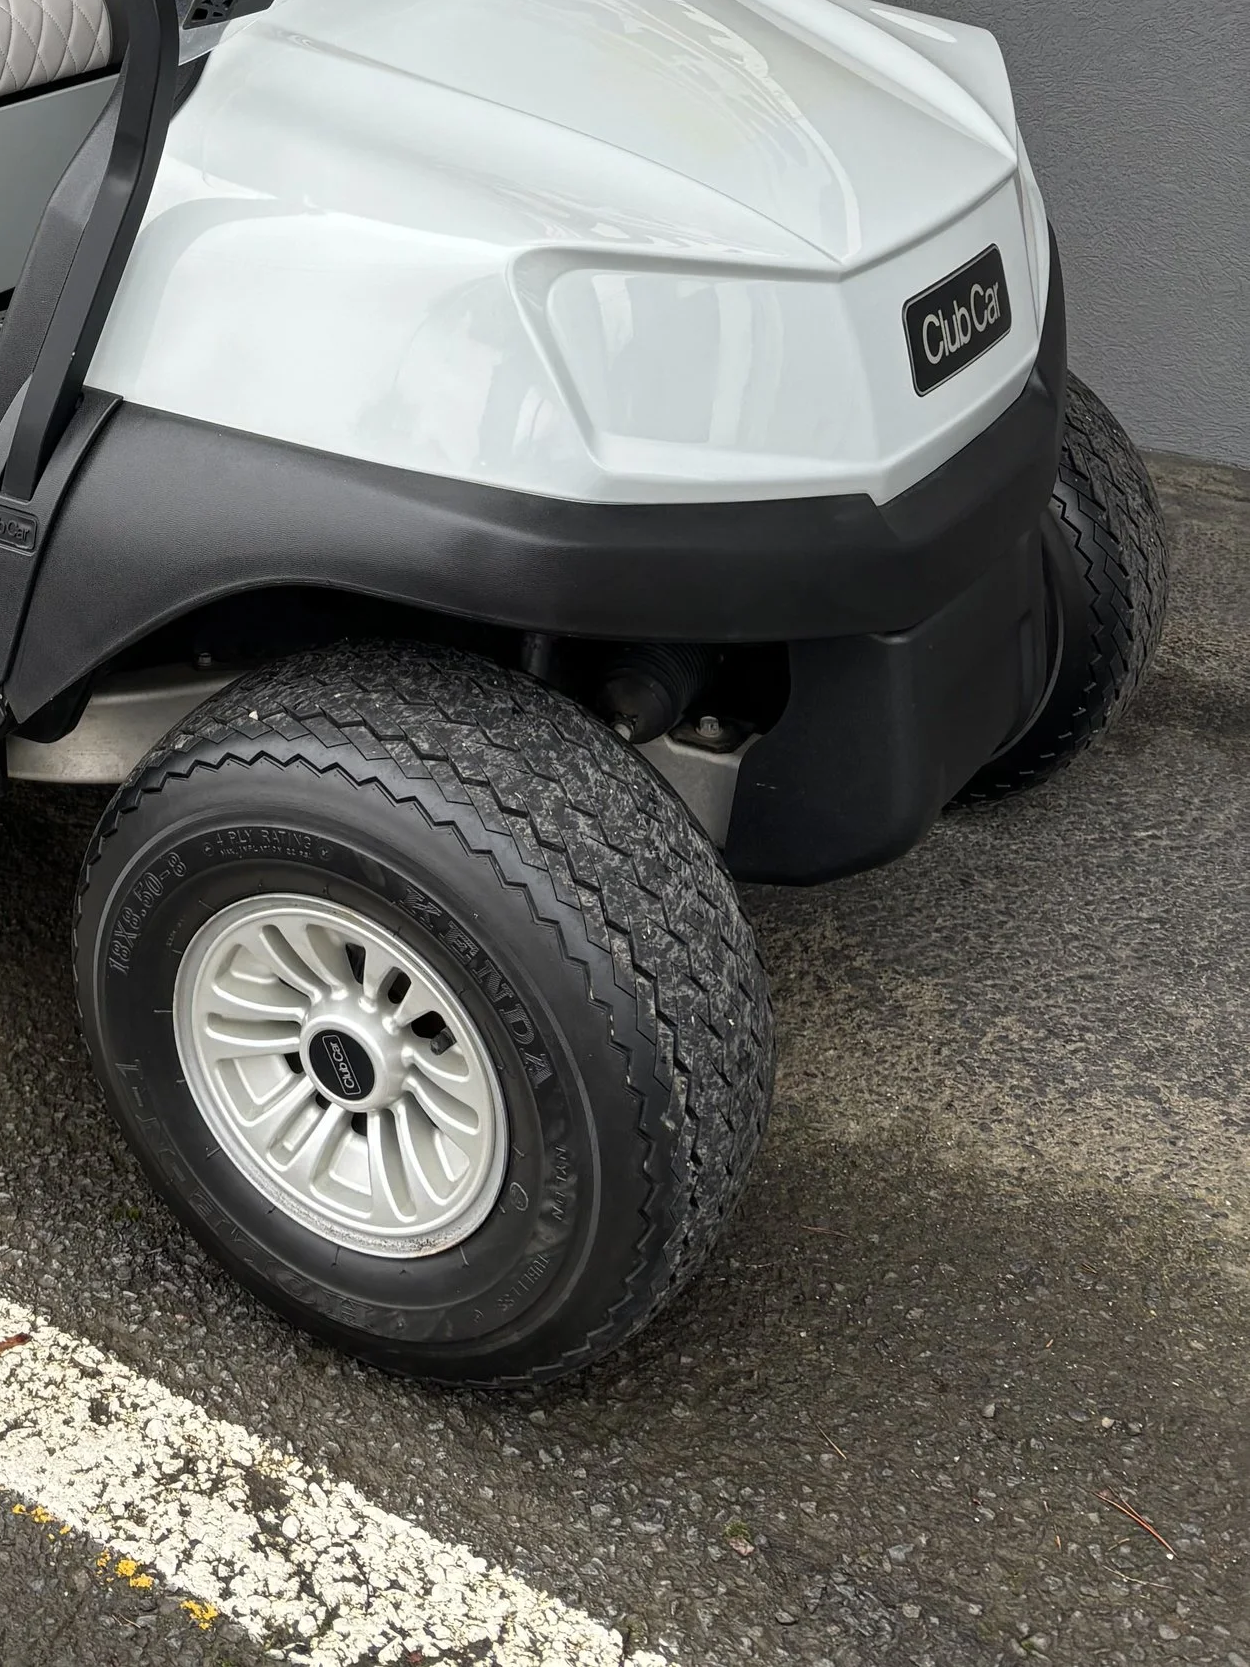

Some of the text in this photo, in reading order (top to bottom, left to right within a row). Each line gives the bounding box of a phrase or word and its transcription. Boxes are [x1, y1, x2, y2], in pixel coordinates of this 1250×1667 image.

[922, 281, 1001, 365] Club Car
[7, 520, 30, 543] Car
[227, 829, 253, 844] PLY
[260, 829, 312, 850] RATING
[108, 850, 187, 978] 18X8.50-8
[397, 883, 553, 1089] KENDA
[329, 1041, 355, 1089] Club Car
